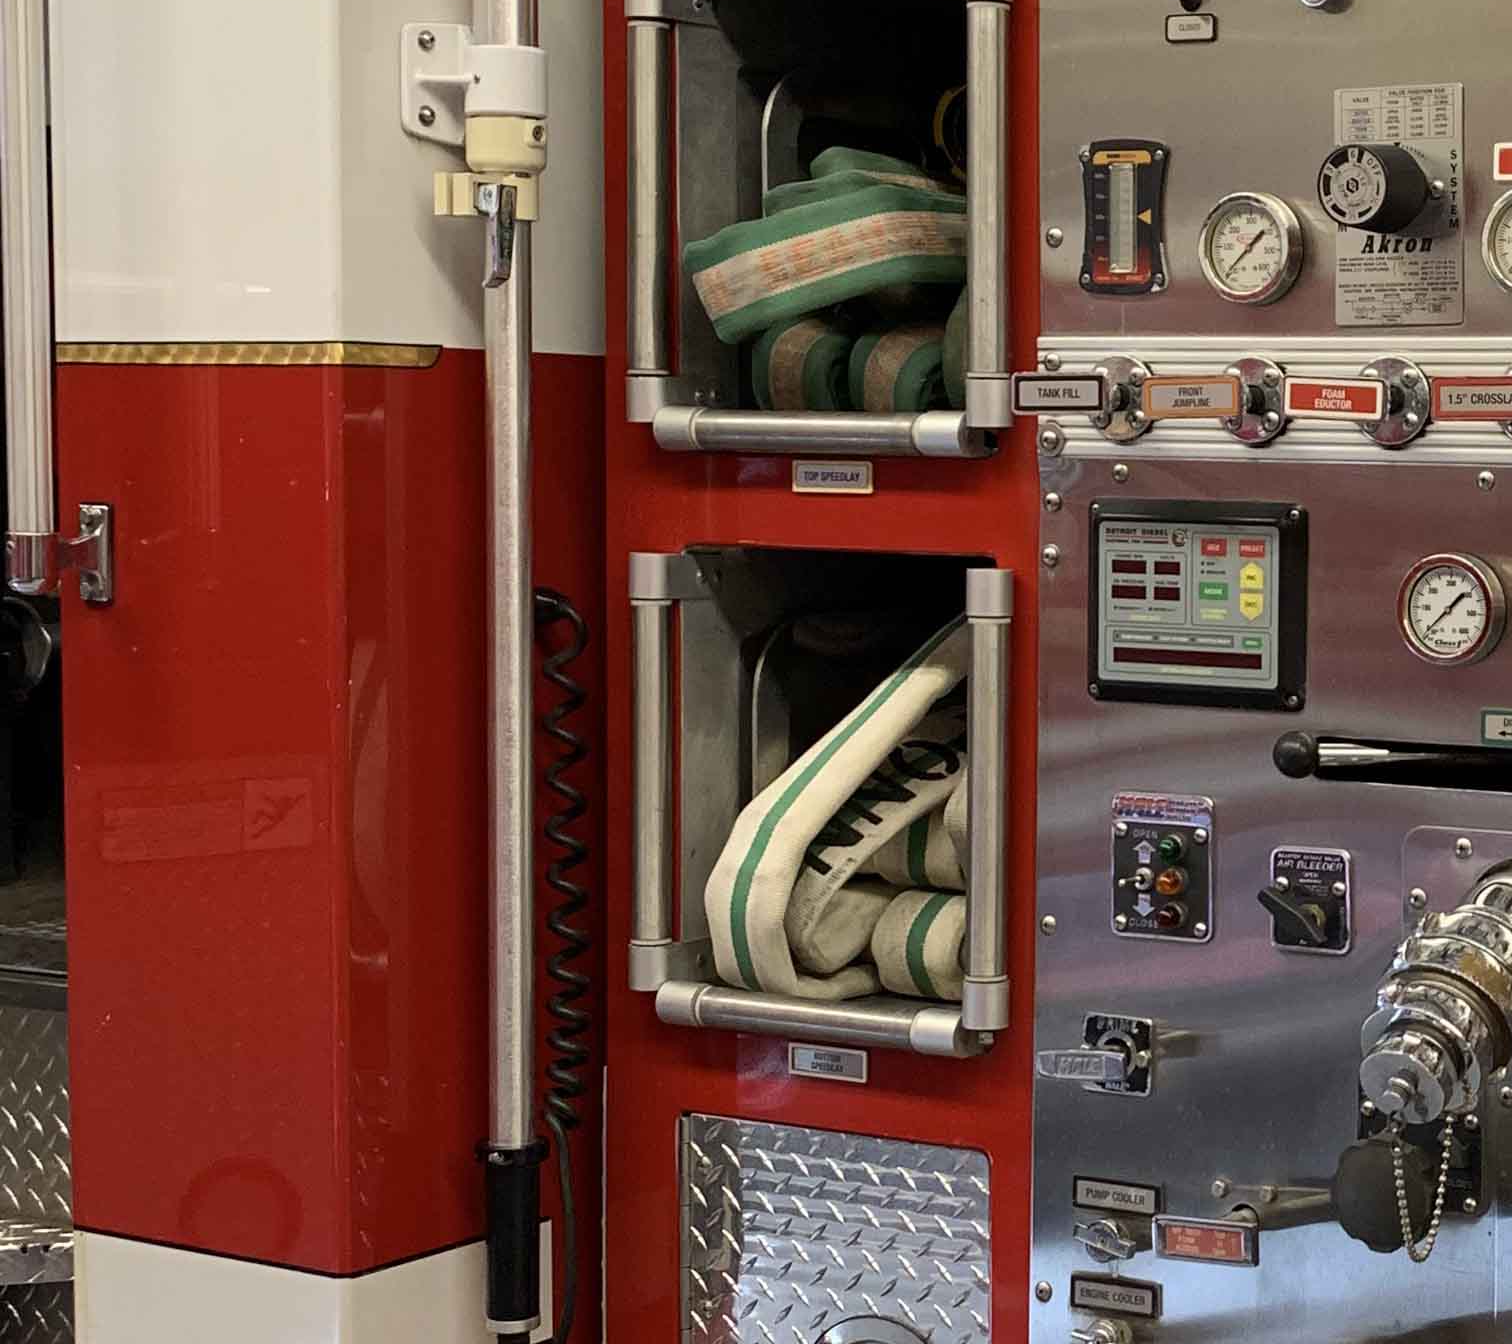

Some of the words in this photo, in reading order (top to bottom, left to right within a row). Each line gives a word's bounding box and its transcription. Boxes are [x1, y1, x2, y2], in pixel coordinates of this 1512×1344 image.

[1361, 235, 1432, 254] Akron
[1037, 388, 1062, 399] TANK
[1064, 389, 1080, 399] FILL
[1178, 386, 1203, 396] FRONT
[1321, 388, 1346, 398] FOAM
[1314, 398, 1352, 410] EDUCTOR
[1448, 393, 1467, 405] 1.5"
[804, 472, 818, 480] TOP
[821, 472, 860, 481] SPEEDLAY
[1277, 859, 1293, 869] AIR
[1296, 860, 1343, 872] BLEEDER
[1086, 1187, 1110, 1201] PUMP
[1113, 1191, 1145, 1205] COOLER
[1080, 1288, 1110, 1299] ENGINE
[1113, 1291, 1145, 1305] COOLER
